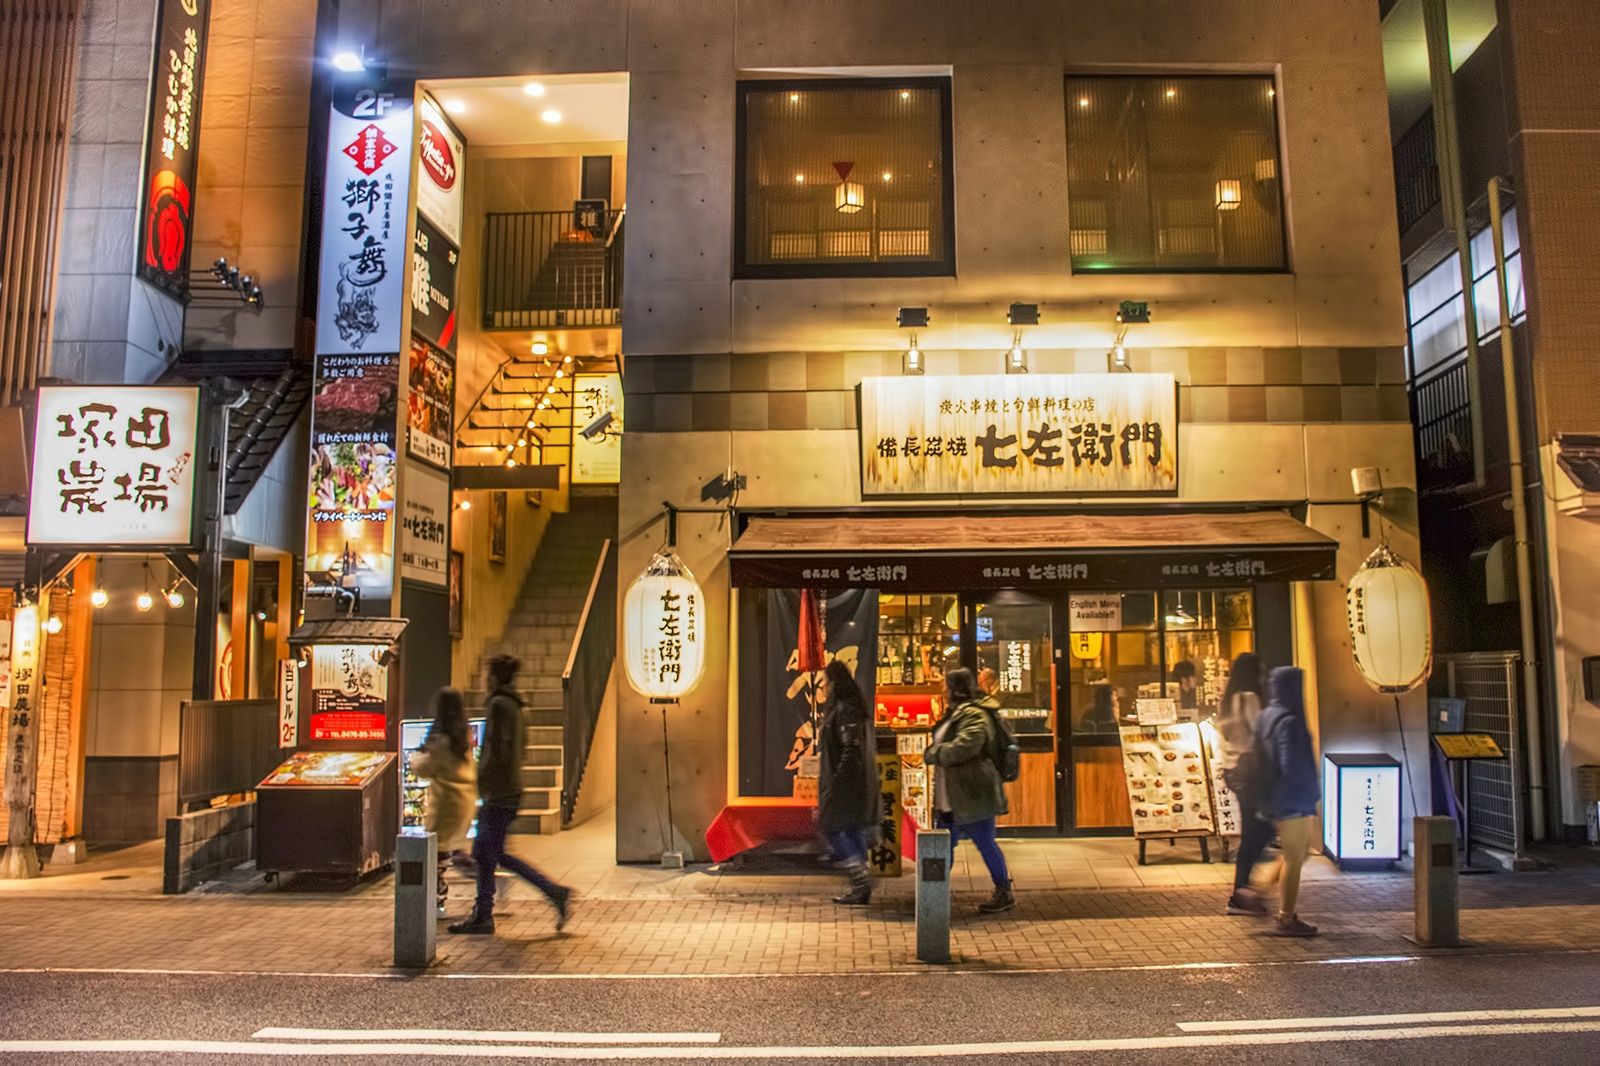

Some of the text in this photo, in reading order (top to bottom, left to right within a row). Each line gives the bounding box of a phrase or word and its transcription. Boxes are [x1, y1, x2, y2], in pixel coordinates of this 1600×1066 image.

[353, 89, 394, 117] 2F
[323, 355, 391, 366] こだわりのお料理を
[940, 397, 1094, 414] 炭火串焼と旬鮮料理の店
[877, 422, 1162, 468] 備長炭焼 七左衛門
[57, 460, 169, 514] 農場
[846, 565, 907, 581] 七左衛門
[1027, 564, 1088, 579] 七左衛門
[1205, 560, 1266, 577] 七左衛門
[1071, 600, 1120, 609] English Menu
[659, 589, 681, 683] 七左衛門
[12, 668, 33, 728] 塚田農場
[282, 663, 295, 742] 当ビル 2F
[1363, 804, 1375, 850] 七左衛門
